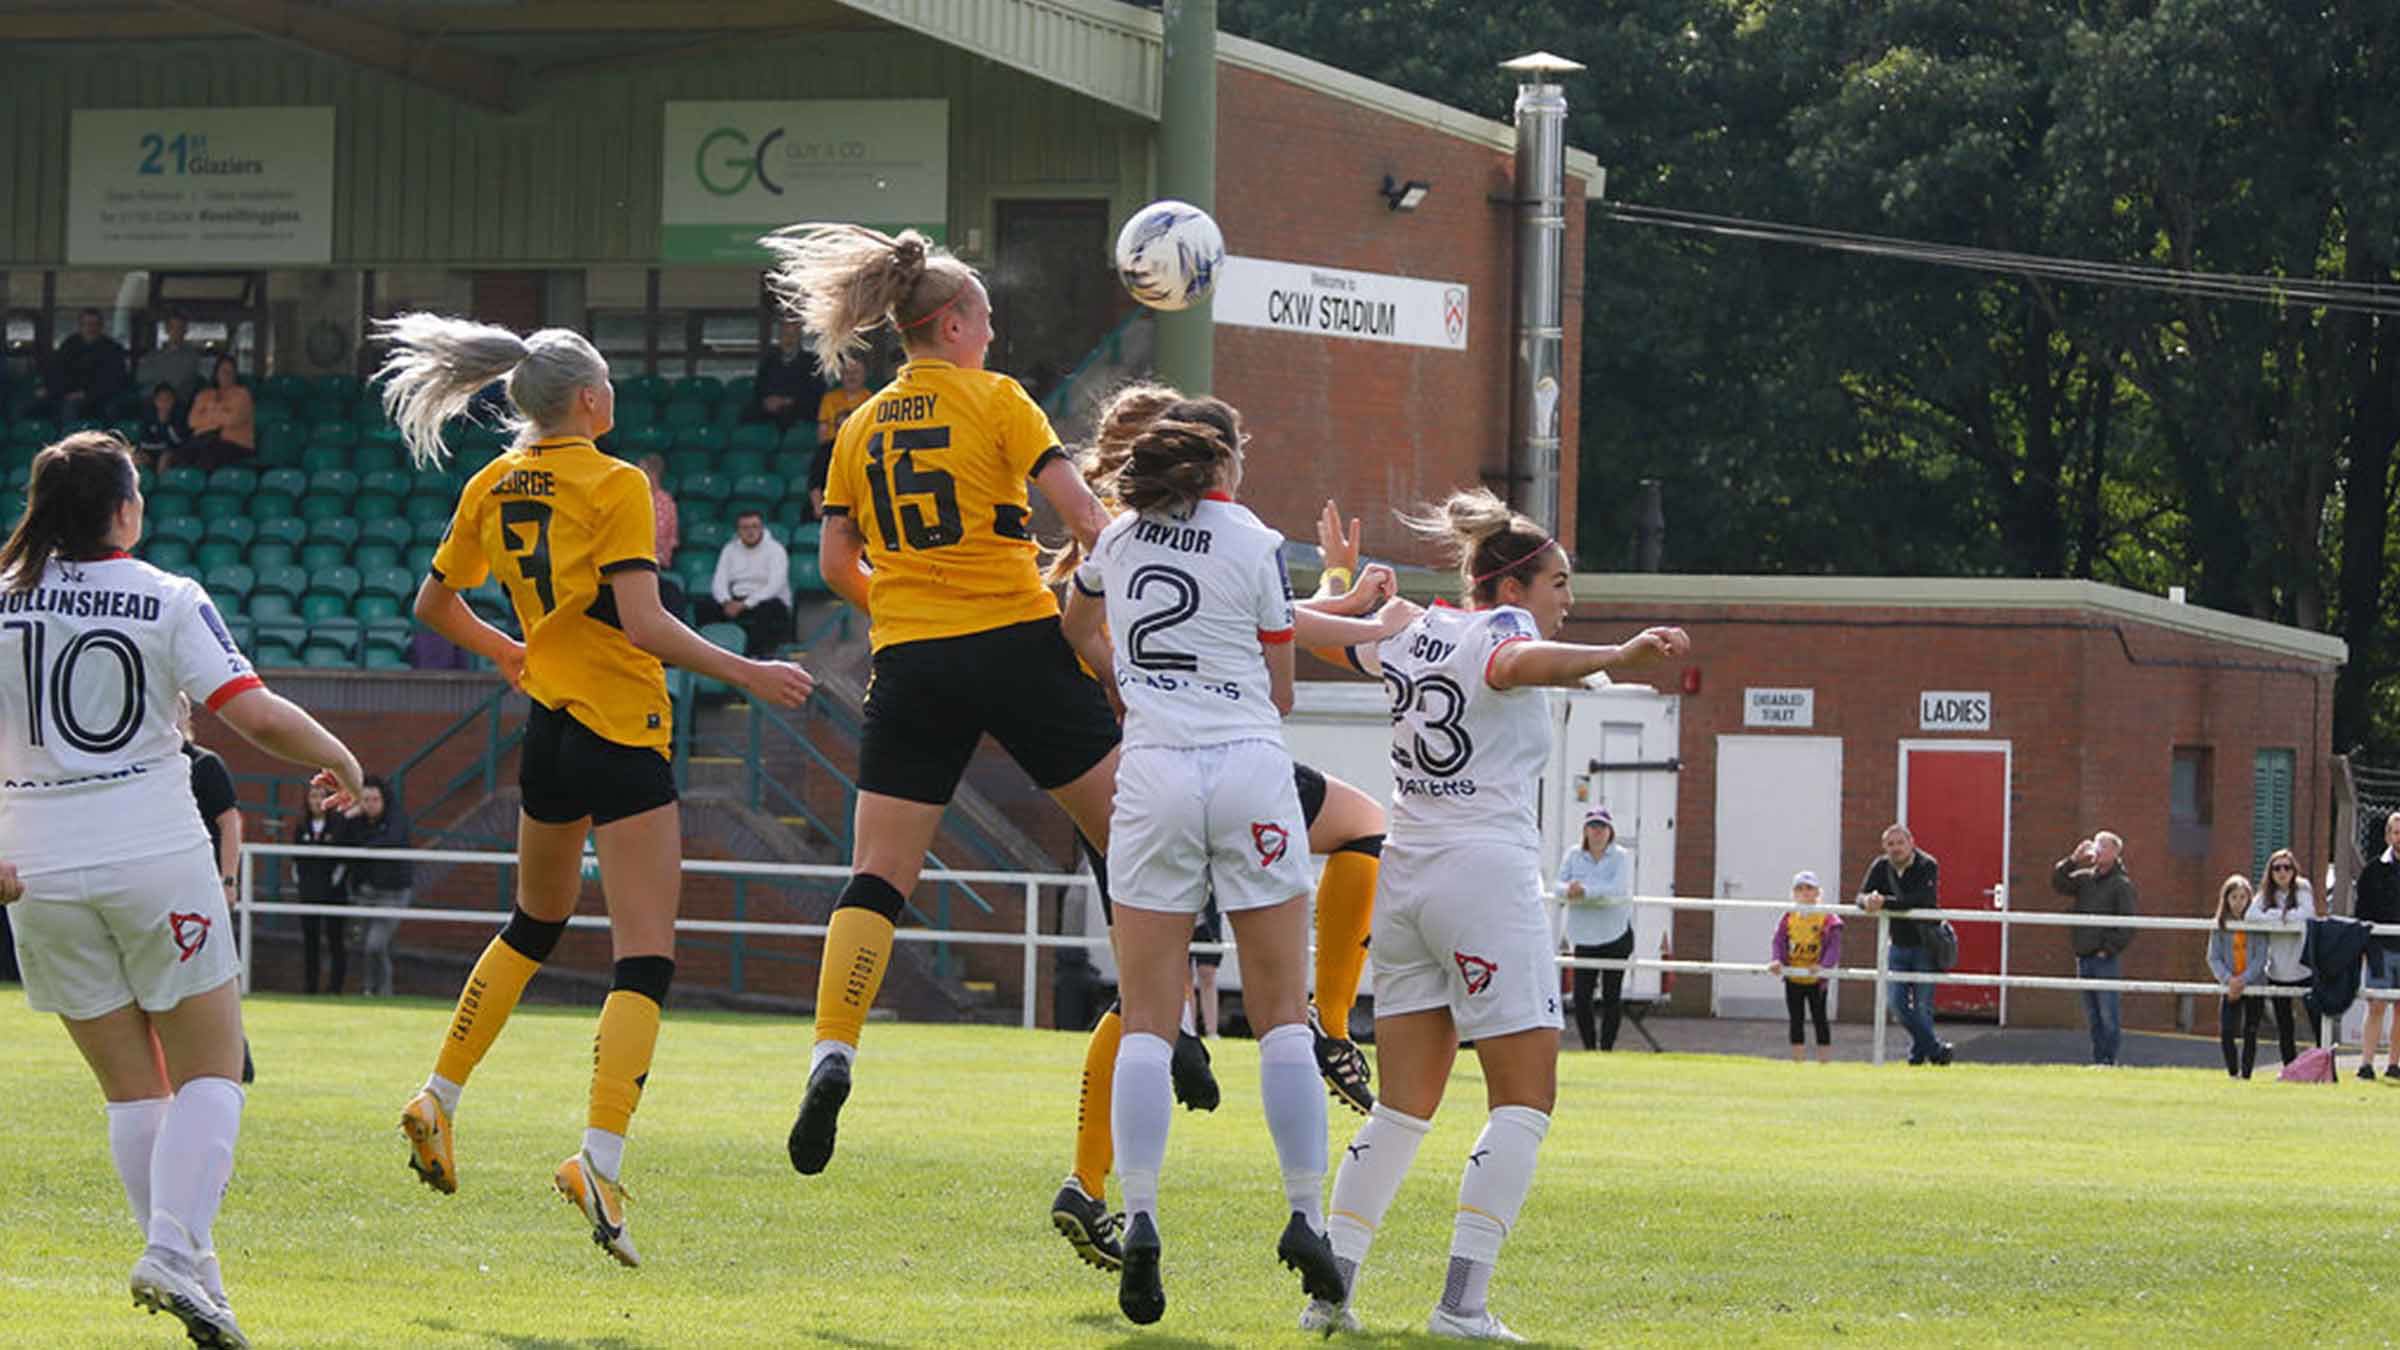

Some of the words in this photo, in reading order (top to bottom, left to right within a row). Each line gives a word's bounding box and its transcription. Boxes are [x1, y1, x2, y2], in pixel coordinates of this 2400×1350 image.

[1268, 290, 1314, 328] CKW
[1320, 295, 1395, 336] STADIUM
[876, 394, 938, 423] DARBY
[866, 426, 963, 552] 15
[501, 500, 556, 615] 7
[1134, 519, 1213, 554] TAYLOR
[1127, 564, 1199, 672] 2
[1410, 634, 1457, 663] COY
[3, 620, 146, 754] 10
[1923, 698, 1987, 724] LADIES
[452, 976, 488, 1042] CASTORE
